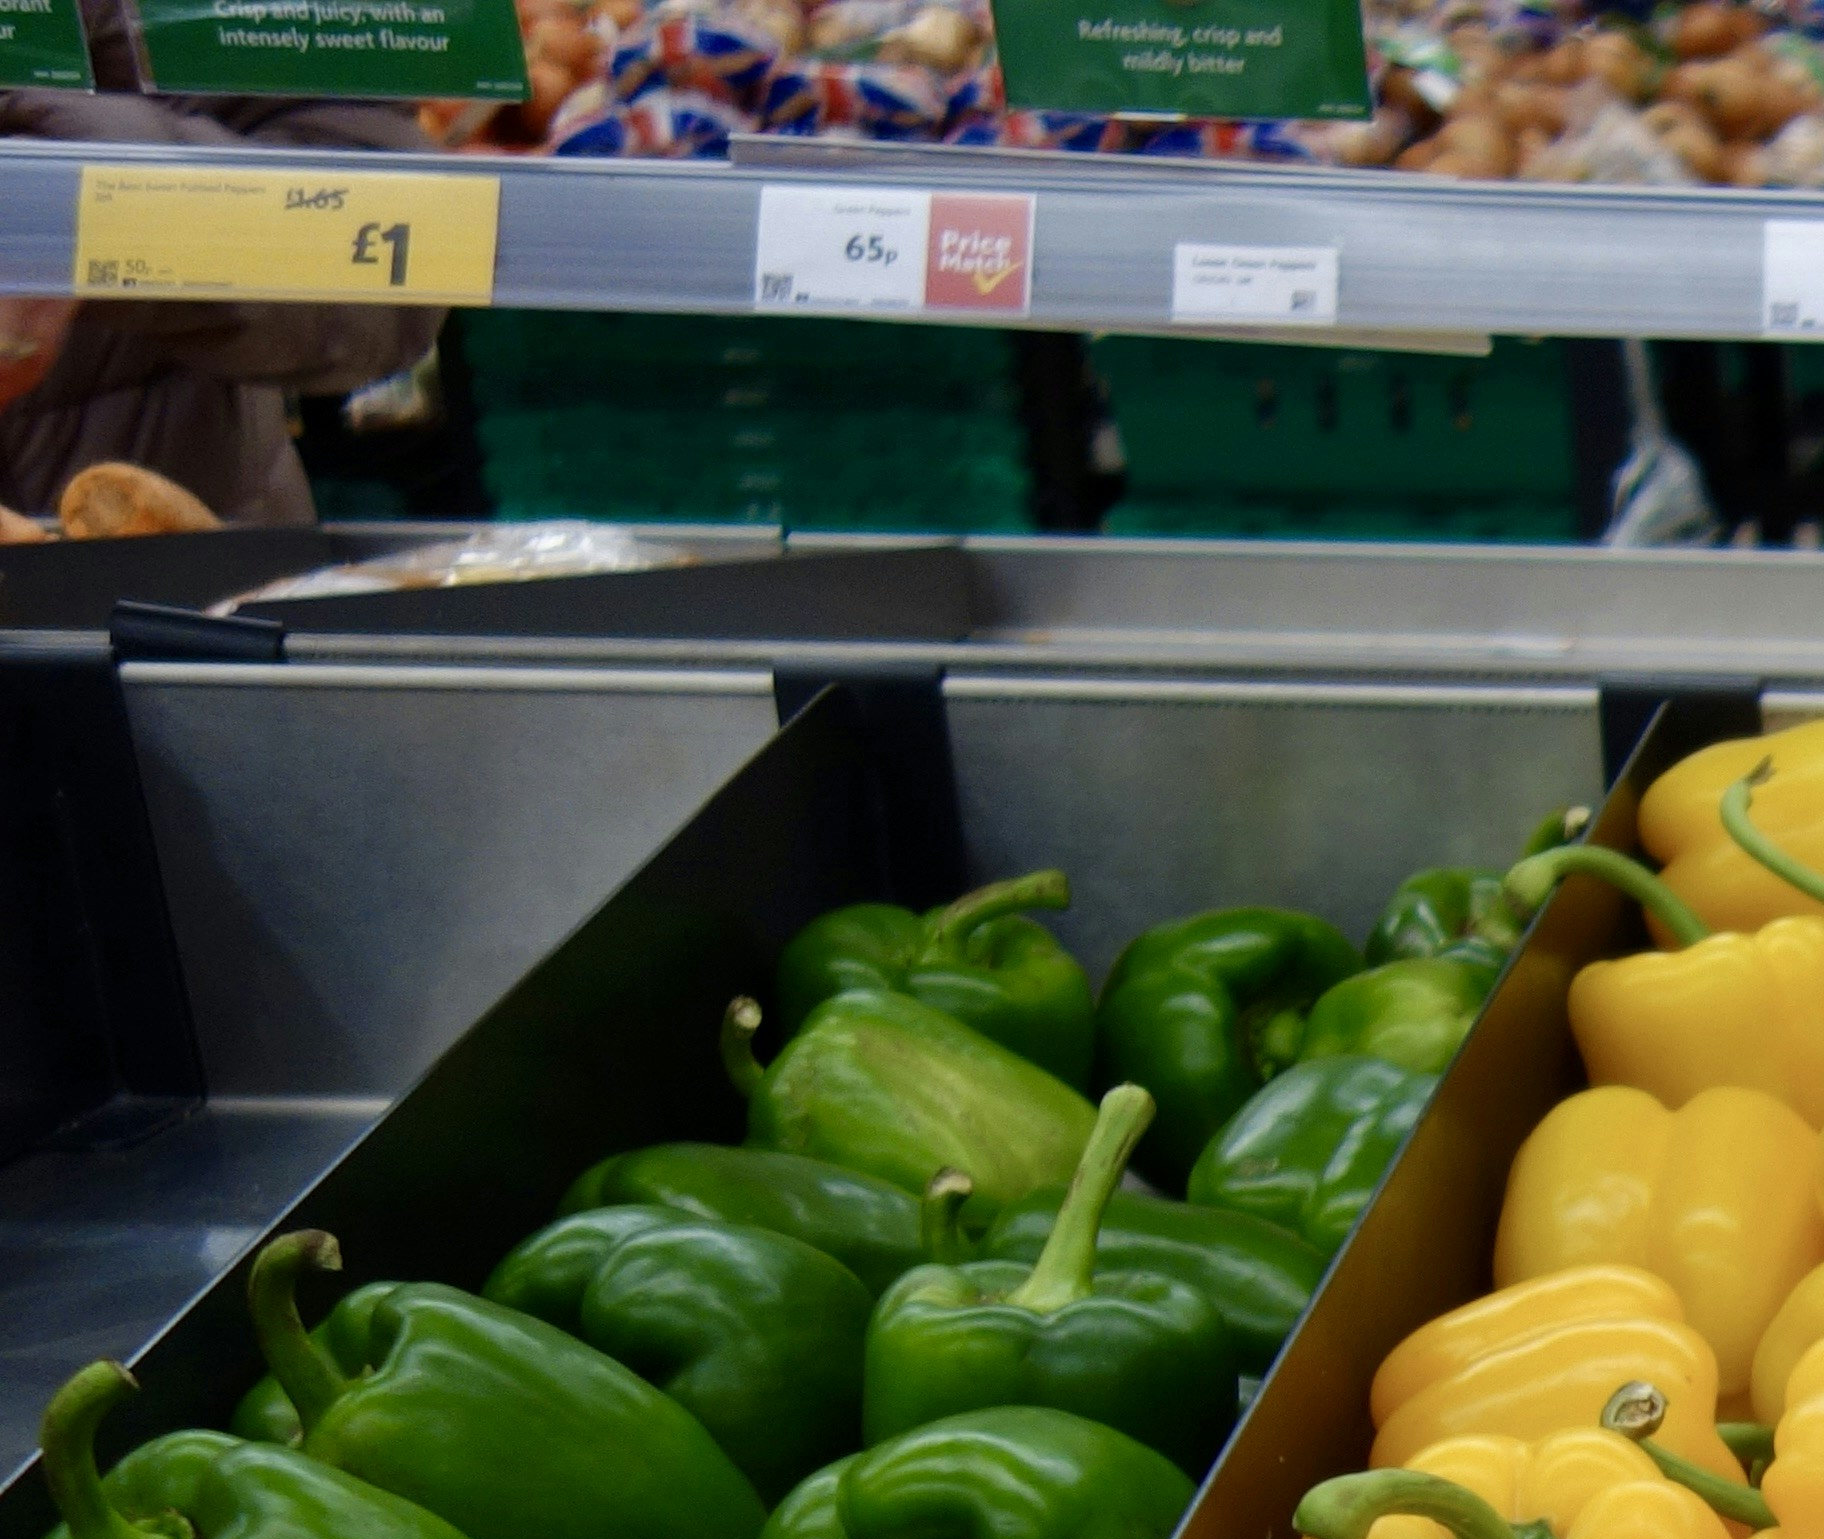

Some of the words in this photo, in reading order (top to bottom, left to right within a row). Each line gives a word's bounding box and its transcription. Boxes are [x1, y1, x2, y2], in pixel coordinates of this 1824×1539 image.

[215, 1, 266, 23] Crisp
[272, 1, 309, 19] and
[315, 2, 367, 25] juicy,
[371, 3, 415, 22] with
[420, 8, 444, 23] an
[219, 26, 309, 52] intensely
[315, 31, 375, 49] sweet
[380, 28, 449, 50] flavour
[1078, 18, 1188, 47] Refreshing,
[1193, 25, 1241, 49] crisp
[1245, 25, 1283, 47] and
[1123, 49, 1182, 76] mildly
[1187, 54, 1245, 74] bitter
[352, 220, 410, 286] £1
[845, 235, 898, 266] 65p
[940, 228, 1011, 256] Price
